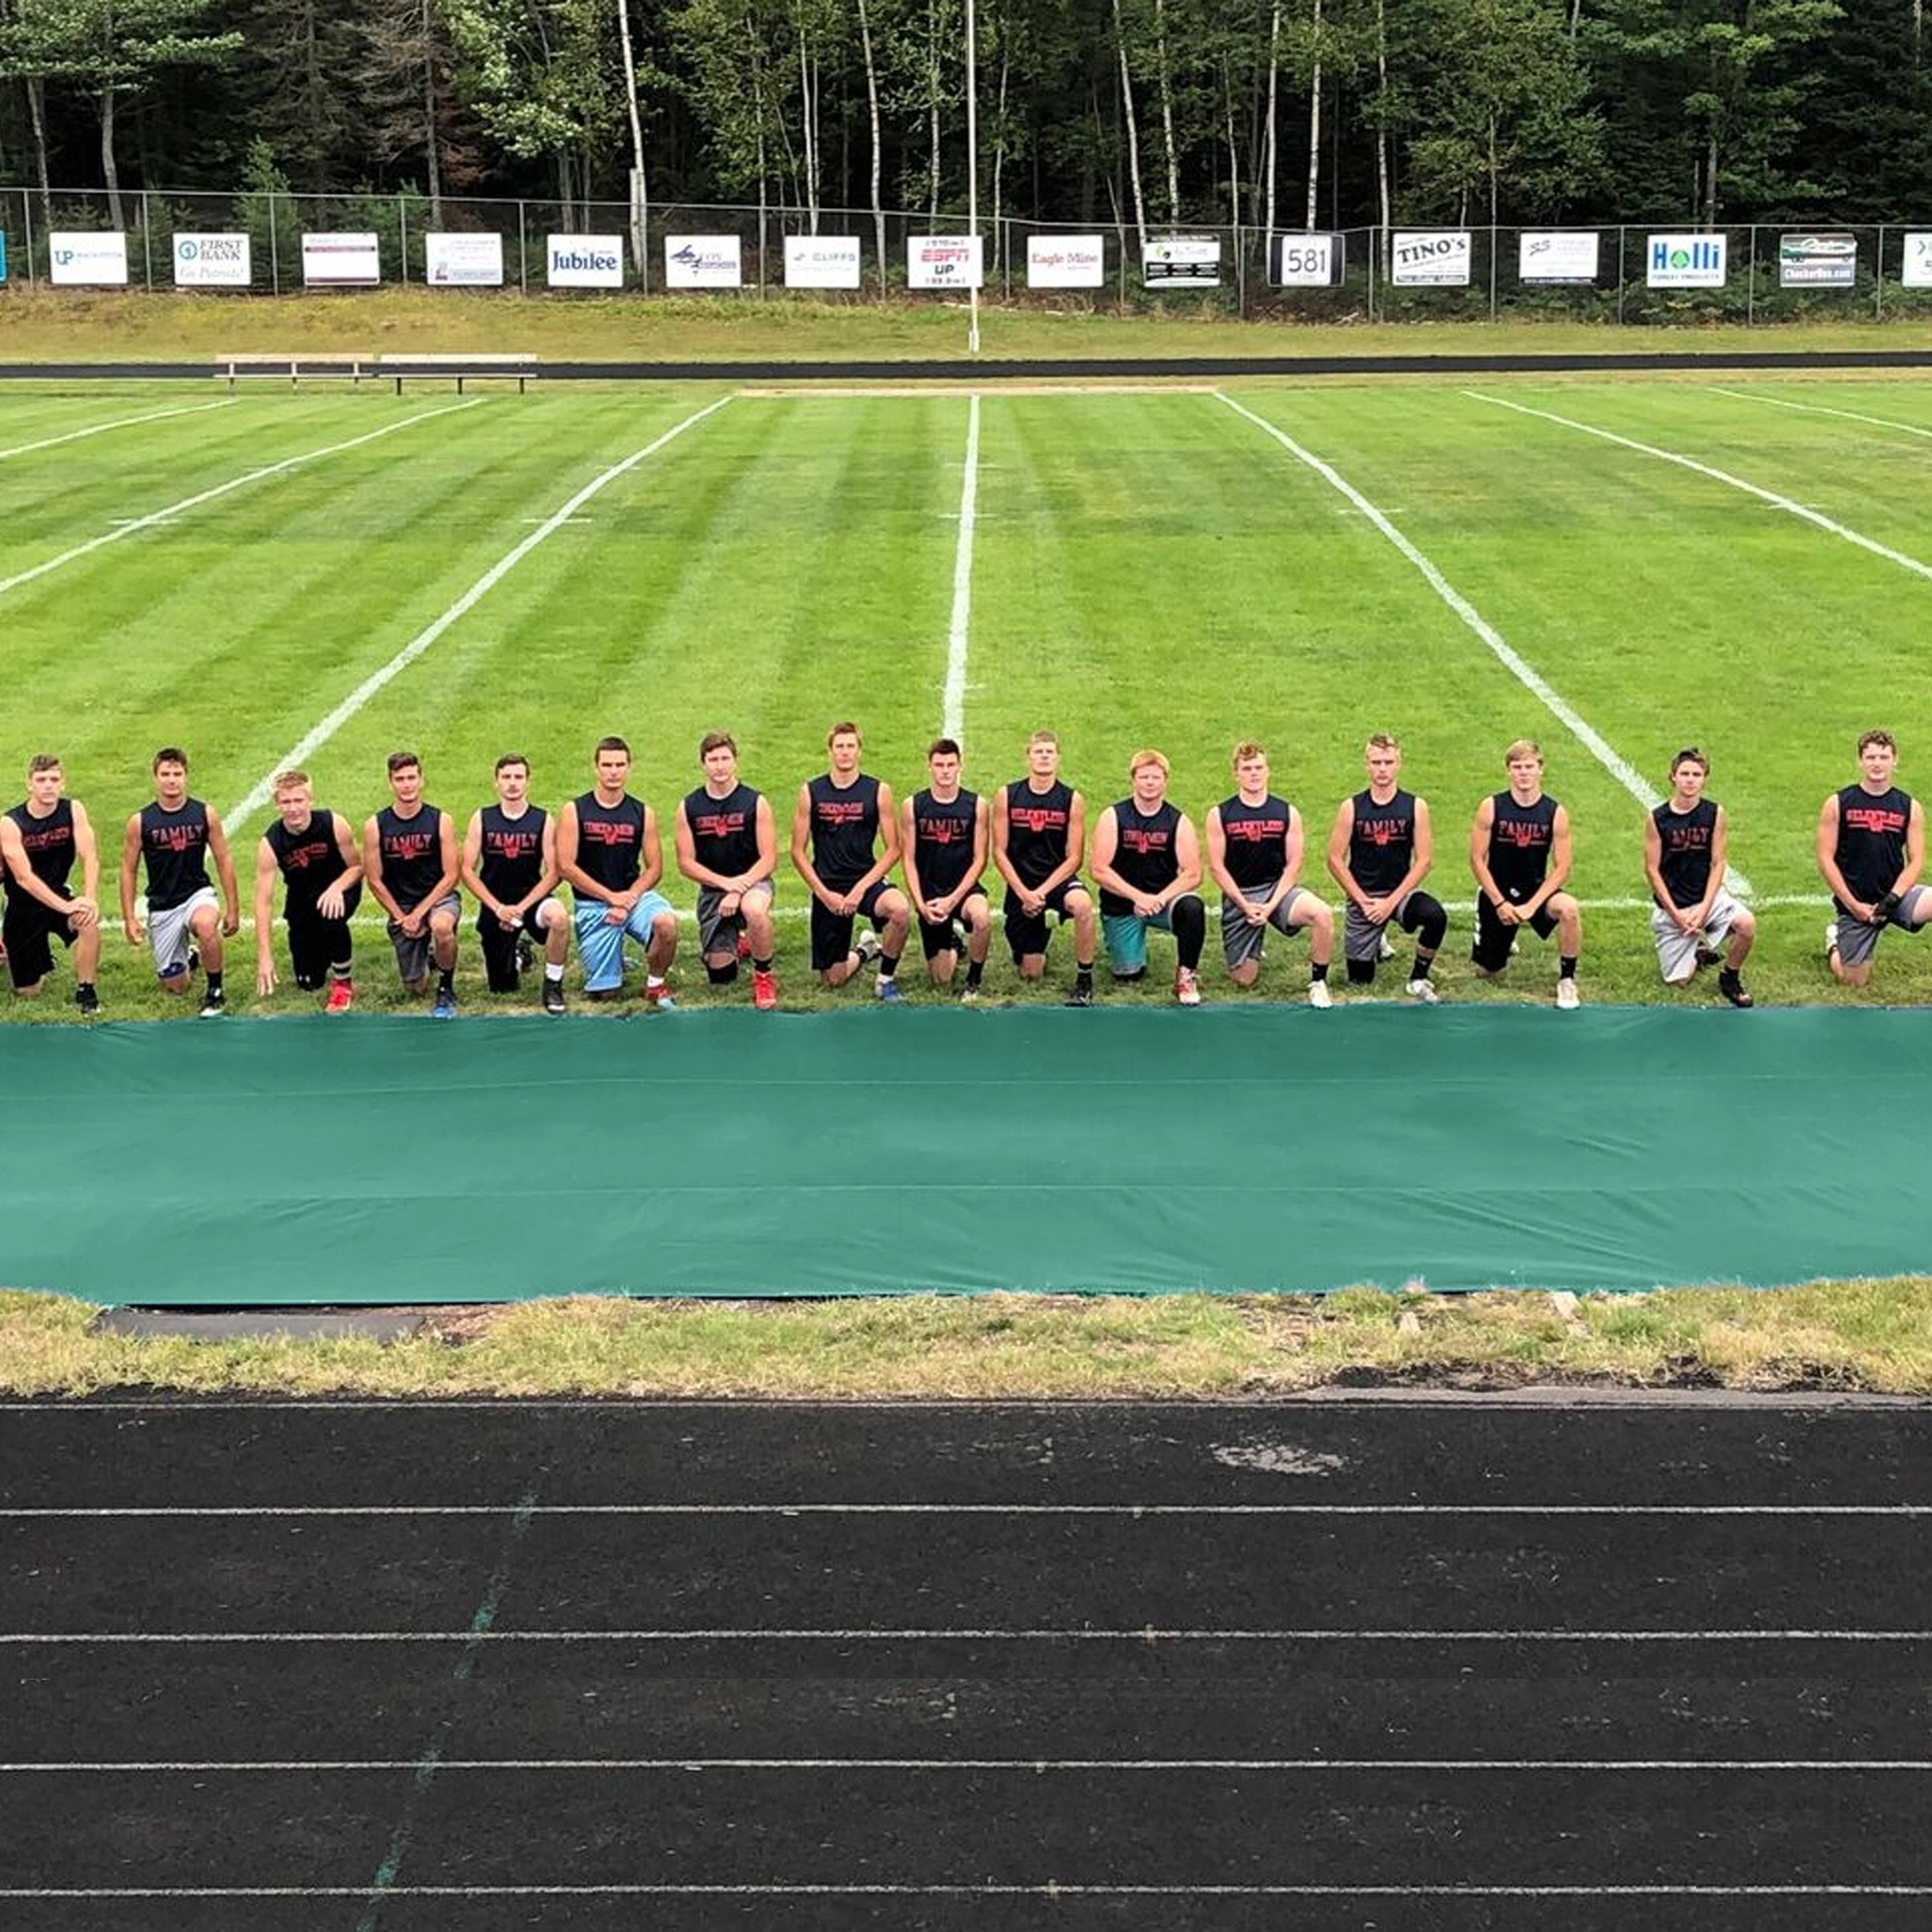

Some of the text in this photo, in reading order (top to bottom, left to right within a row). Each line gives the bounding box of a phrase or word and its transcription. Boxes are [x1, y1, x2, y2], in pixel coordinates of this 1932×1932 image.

[200, 240, 243, 249] FIRST
[1397, 237, 1466, 263] TINO's
[55, 250, 74, 266] UP
[200, 250, 240, 261] BANK
[553, 251, 617, 272] Jubilee
[921, 248, 969, 262] ESPN
[1032, 252, 1064, 268] Eagle
[1288, 248, 1325, 273] 581
[1653, 242, 1720, 270] Holli
[935, 264, 955, 275] UP
[919, 818, 969, 834] FAMILY
[1356, 819, 1406, 835] FAMILY
[1499, 820, 1549, 838] FAMILY
[152, 825, 203, 844] FAMILY
[487, 831, 538, 848] FAMILY
[384, 834, 432, 852] FAMILY
